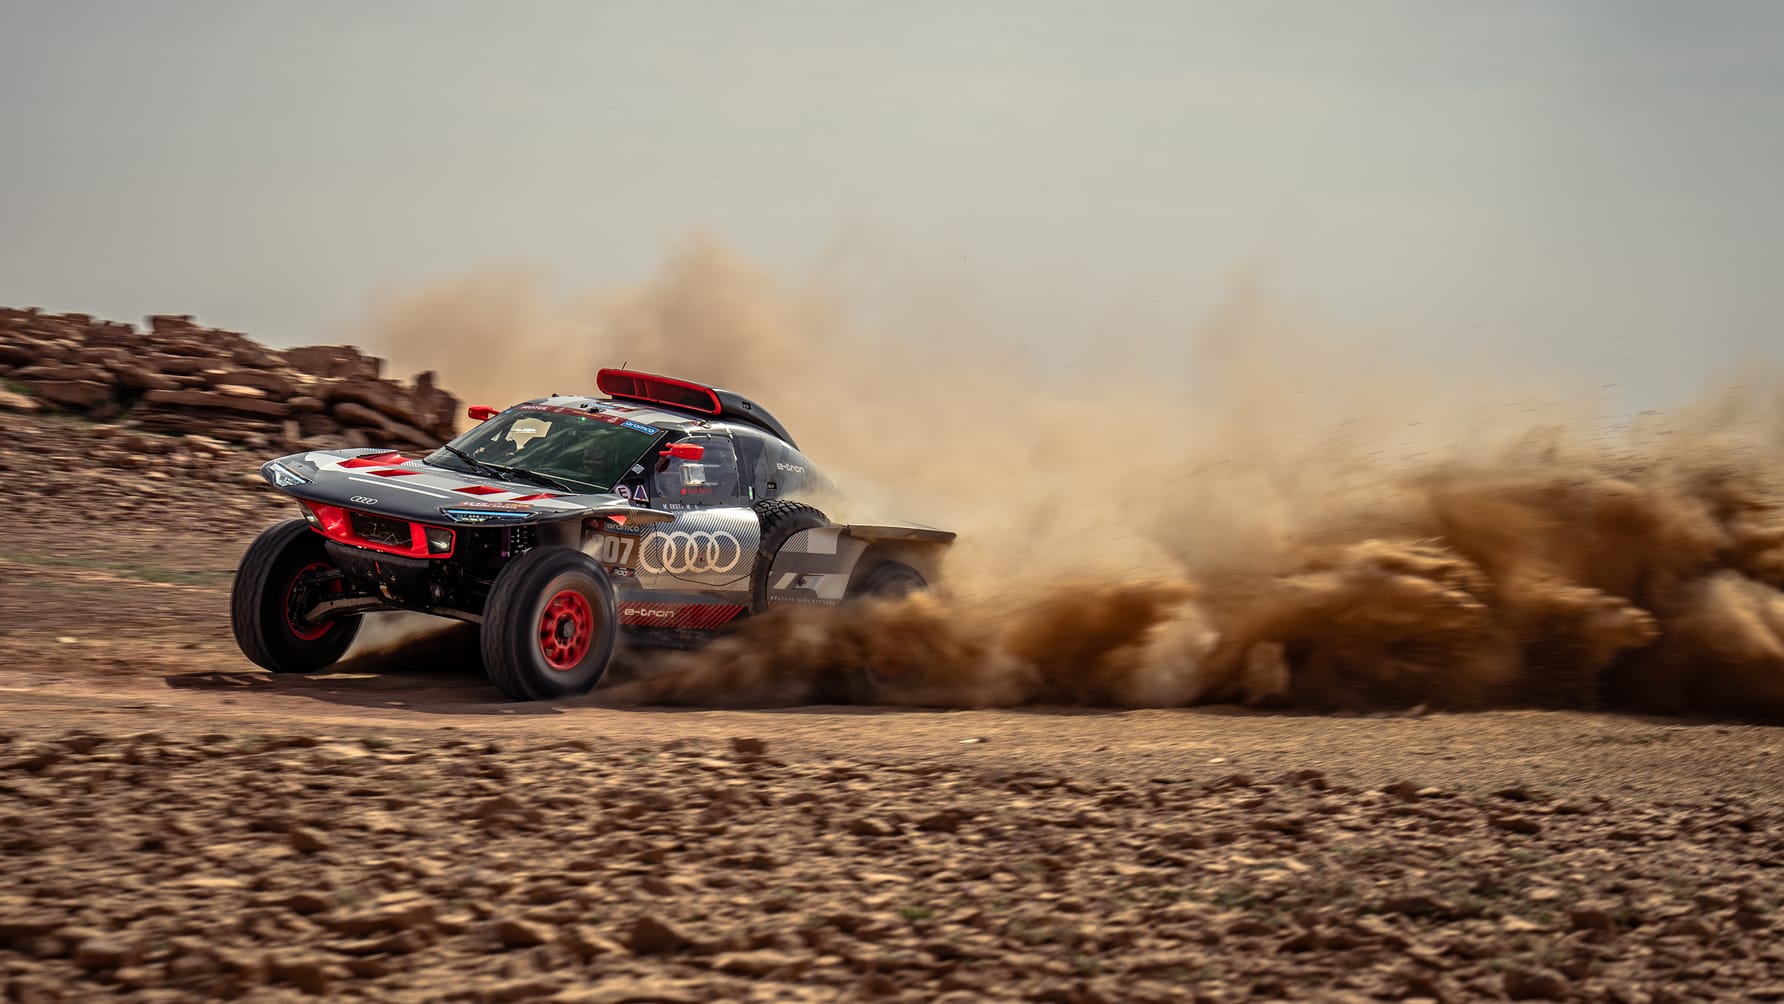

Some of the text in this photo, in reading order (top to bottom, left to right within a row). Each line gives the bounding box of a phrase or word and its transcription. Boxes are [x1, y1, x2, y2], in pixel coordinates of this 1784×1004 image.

[624, 421, 656, 434] aramco
[776, 462, 806, 473] e-tron
[606, 523, 640, 532] aramco
[624, 608, 675, 618] e-tron
